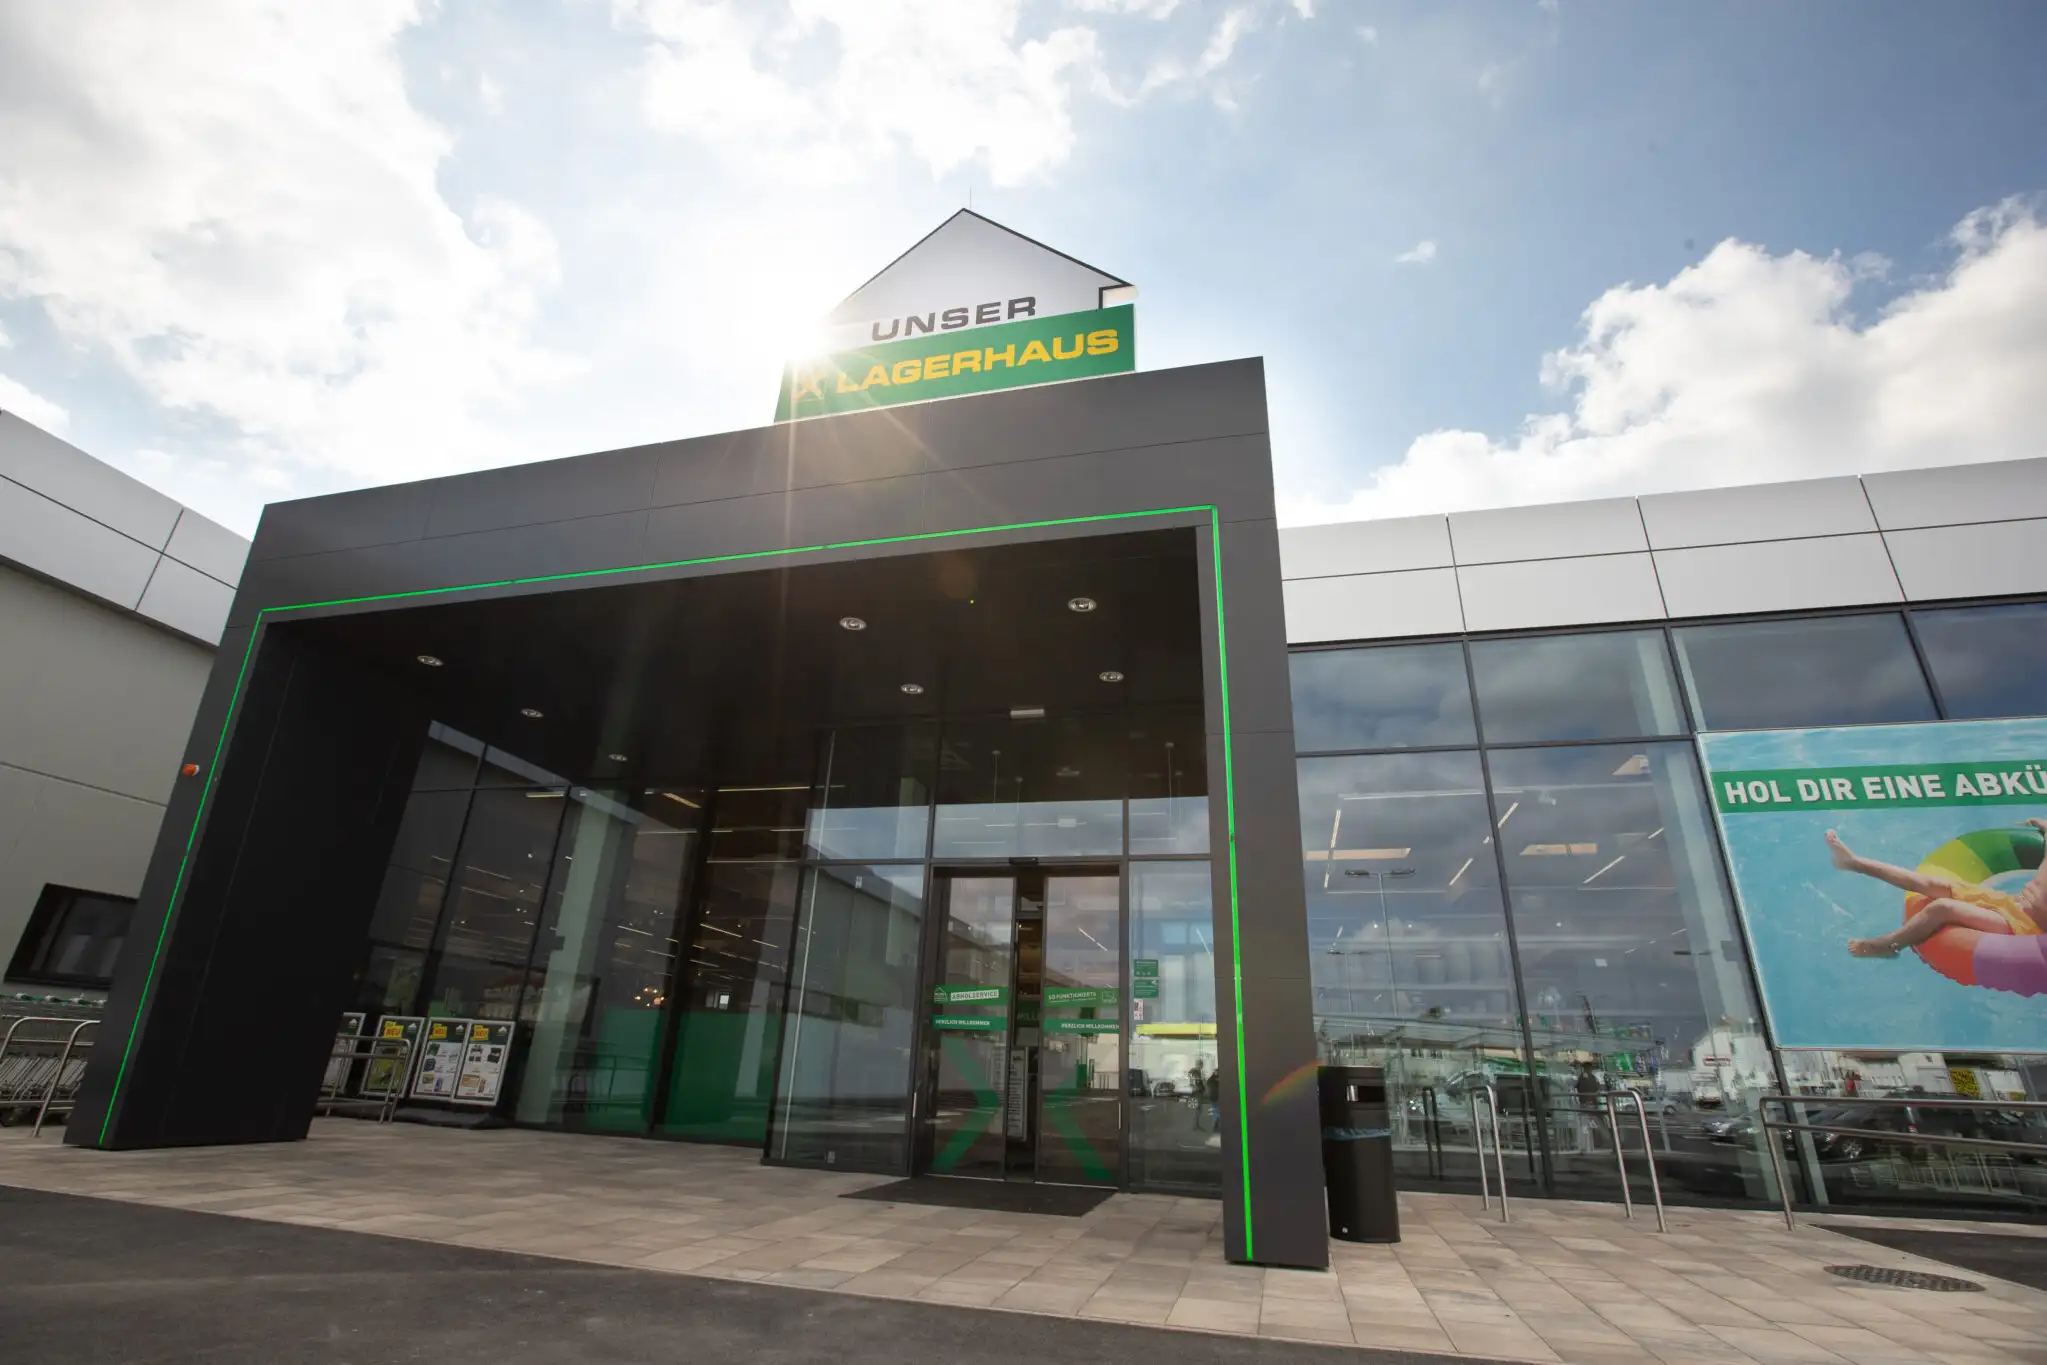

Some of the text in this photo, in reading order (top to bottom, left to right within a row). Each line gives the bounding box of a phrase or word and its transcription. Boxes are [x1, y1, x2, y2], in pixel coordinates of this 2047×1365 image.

[872, 296, 1037, 342] UNSER
[836, 329, 1120, 394] LAGERHAUS
[1724, 779, 1793, 805] HOL
[1797, 777, 1858, 803] DIR
[1862, 774, 1947, 800] EINE
[951, 990, 998, 1000] ABHOLSERVICE
